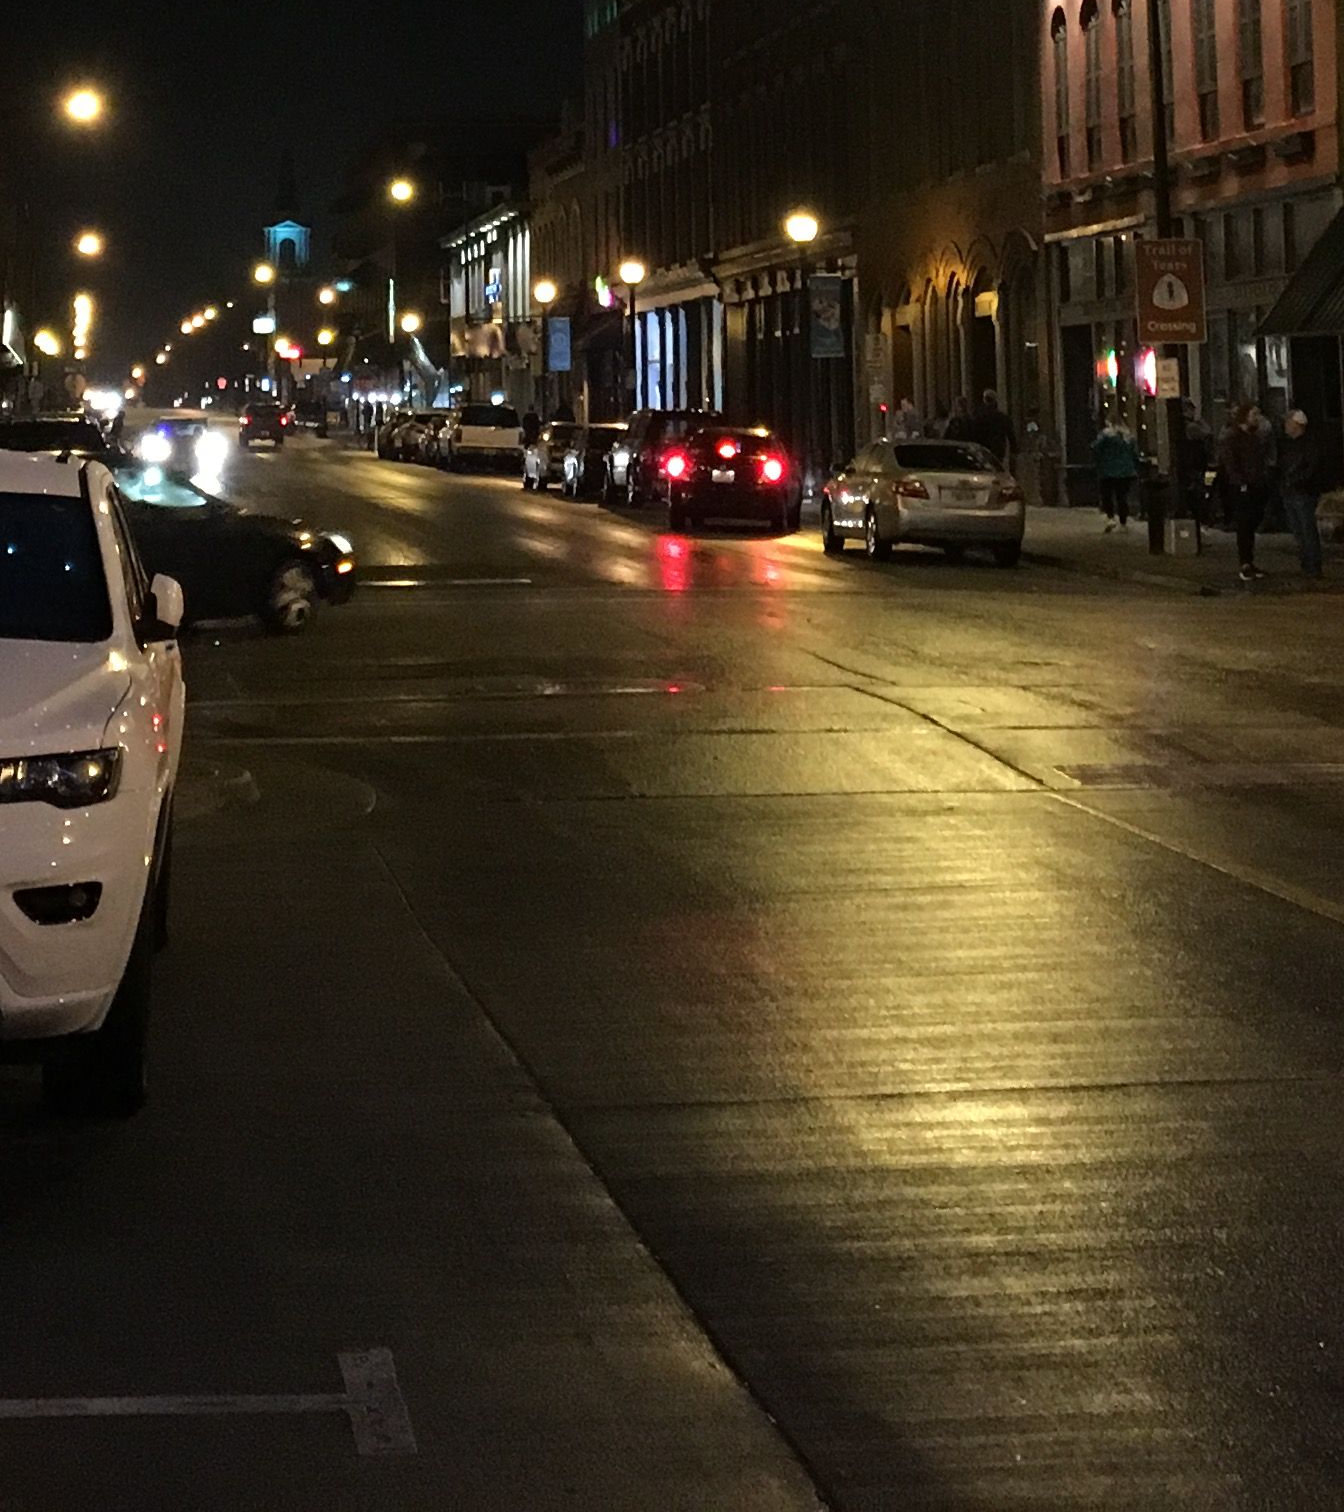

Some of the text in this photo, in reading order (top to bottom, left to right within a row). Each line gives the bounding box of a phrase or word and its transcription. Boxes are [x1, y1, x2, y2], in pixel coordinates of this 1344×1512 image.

[1144, 244, 1193, 256] Trail of
[1147, 320, 1197, 334] Crossing
